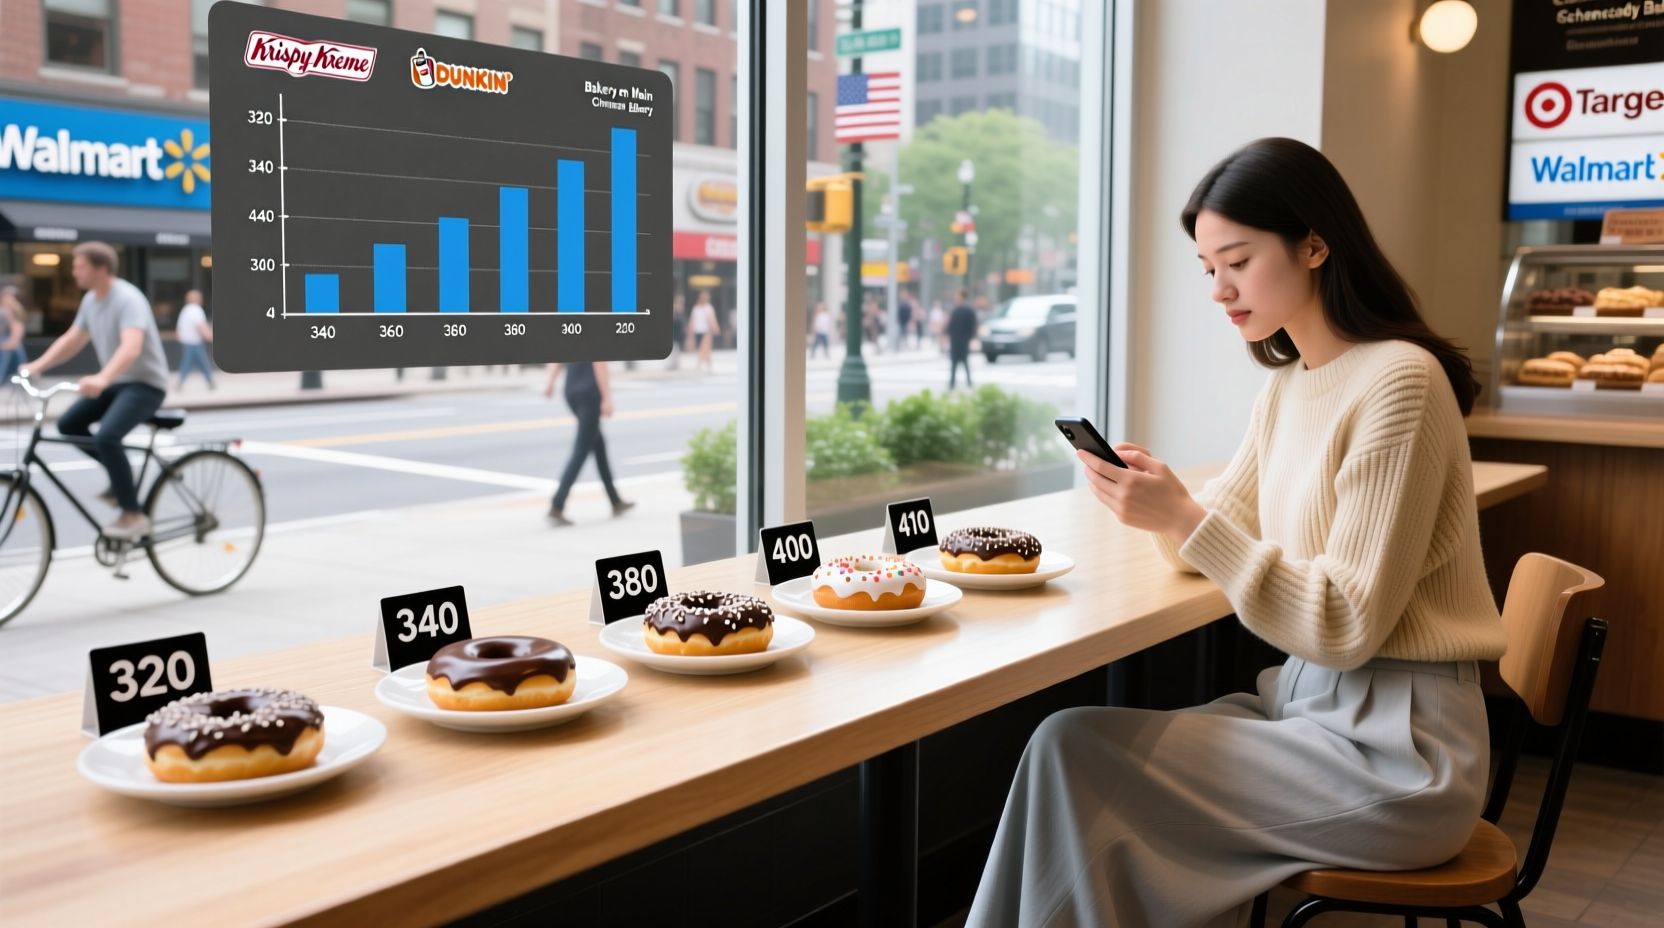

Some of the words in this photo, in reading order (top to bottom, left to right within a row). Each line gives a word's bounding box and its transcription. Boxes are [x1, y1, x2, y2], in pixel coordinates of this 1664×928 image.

[250, 37, 312, 73] Krispy
[313, 45, 369, 72] Kreme
[247, 110, 273, 125] 320
[0, 123, 164, 181] Walmart
[248, 159, 274, 174] 340
[1531, 153, 1655, 183] Walmart
[248, 209, 275, 223] 440
[310, 325, 336, 339] 340
[379, 324, 404, 338] 360
[898, 509, 930, 538] 410
[772, 533, 813, 564] 400
[607, 564, 658, 600] 380
[396, 601, 459, 642] 340
[109, 650, 196, 702] 320
